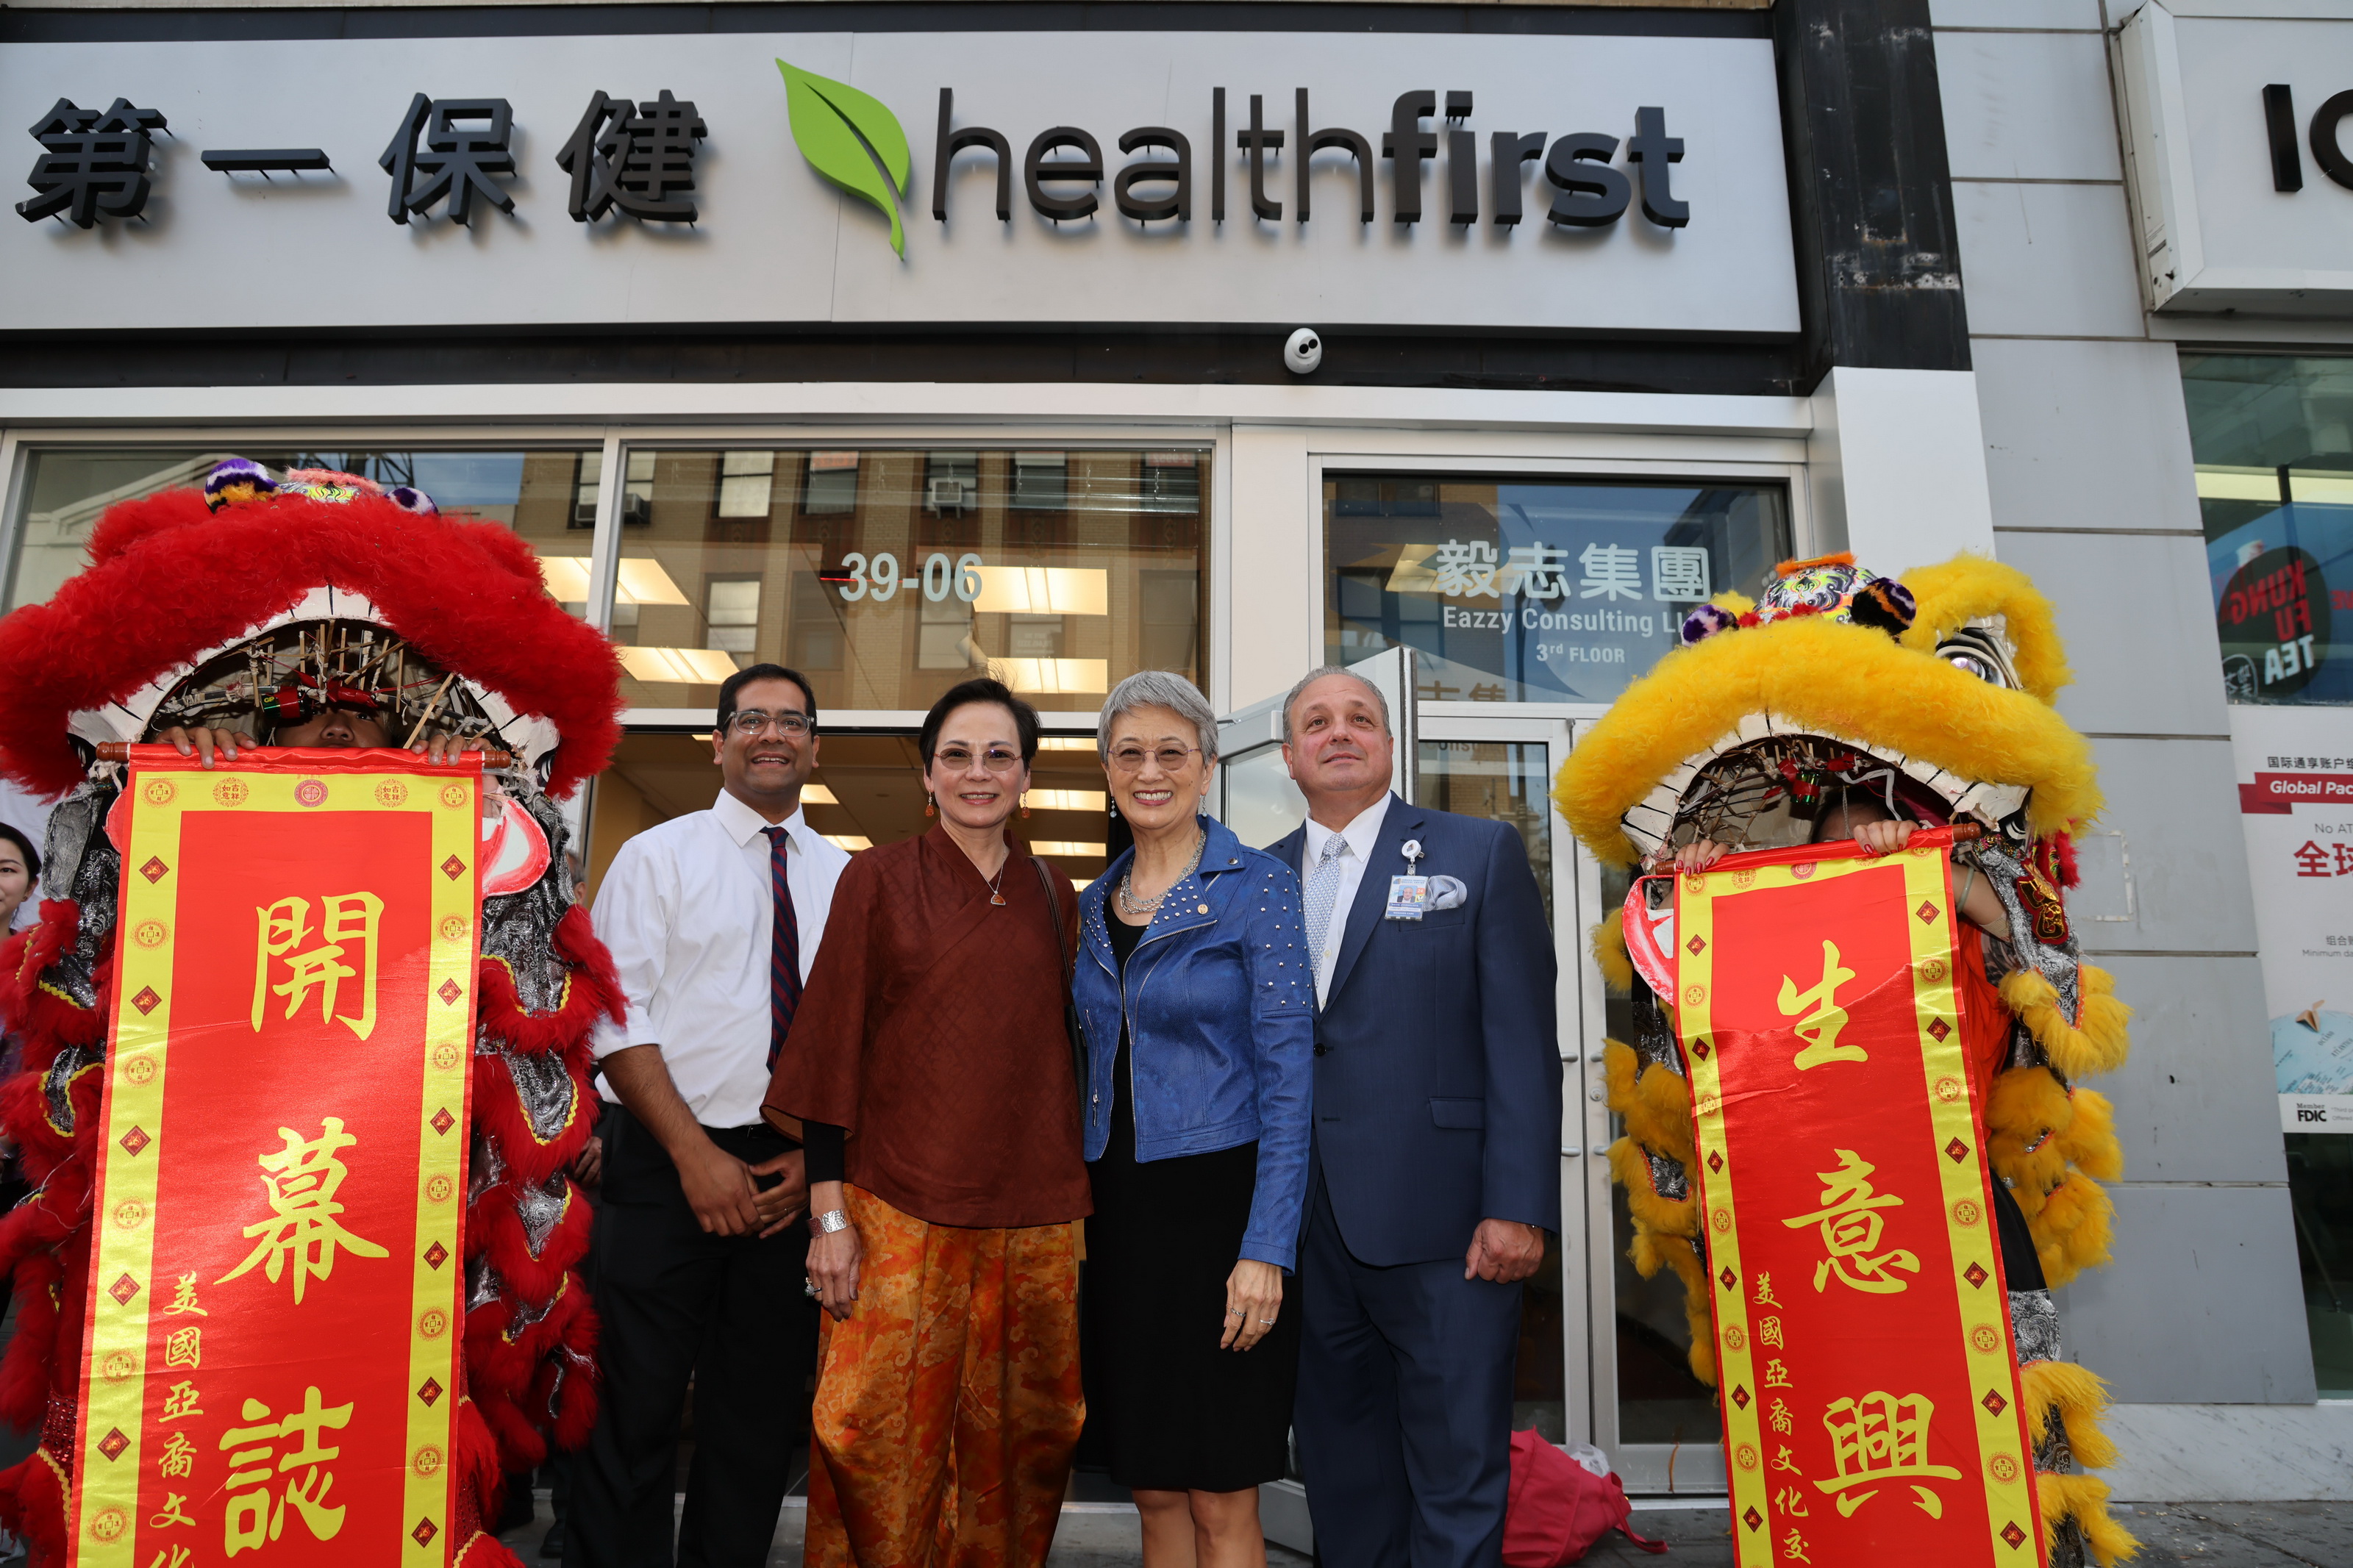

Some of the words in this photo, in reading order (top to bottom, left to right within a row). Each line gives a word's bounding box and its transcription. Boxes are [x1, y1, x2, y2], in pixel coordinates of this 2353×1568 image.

[15, 89, 708, 229] 第一保健
[932, 86, 1690, 228] healthfirst
[839, 552, 983, 602] 39-06
[1436, 539, 1711, 602] 毅志集團
[1443, 606, 1513, 634] Eazzy
[1522, 607, 1653, 637] Consulting
[1536, 643, 1563, 661] 3rd
[1569, 647, 1625, 663] FLOOR
[2270, 780, 2321, 794] Global
[2315, 823, 2333, 834] No
[2297, 1110, 2327, 1122] FDIC
